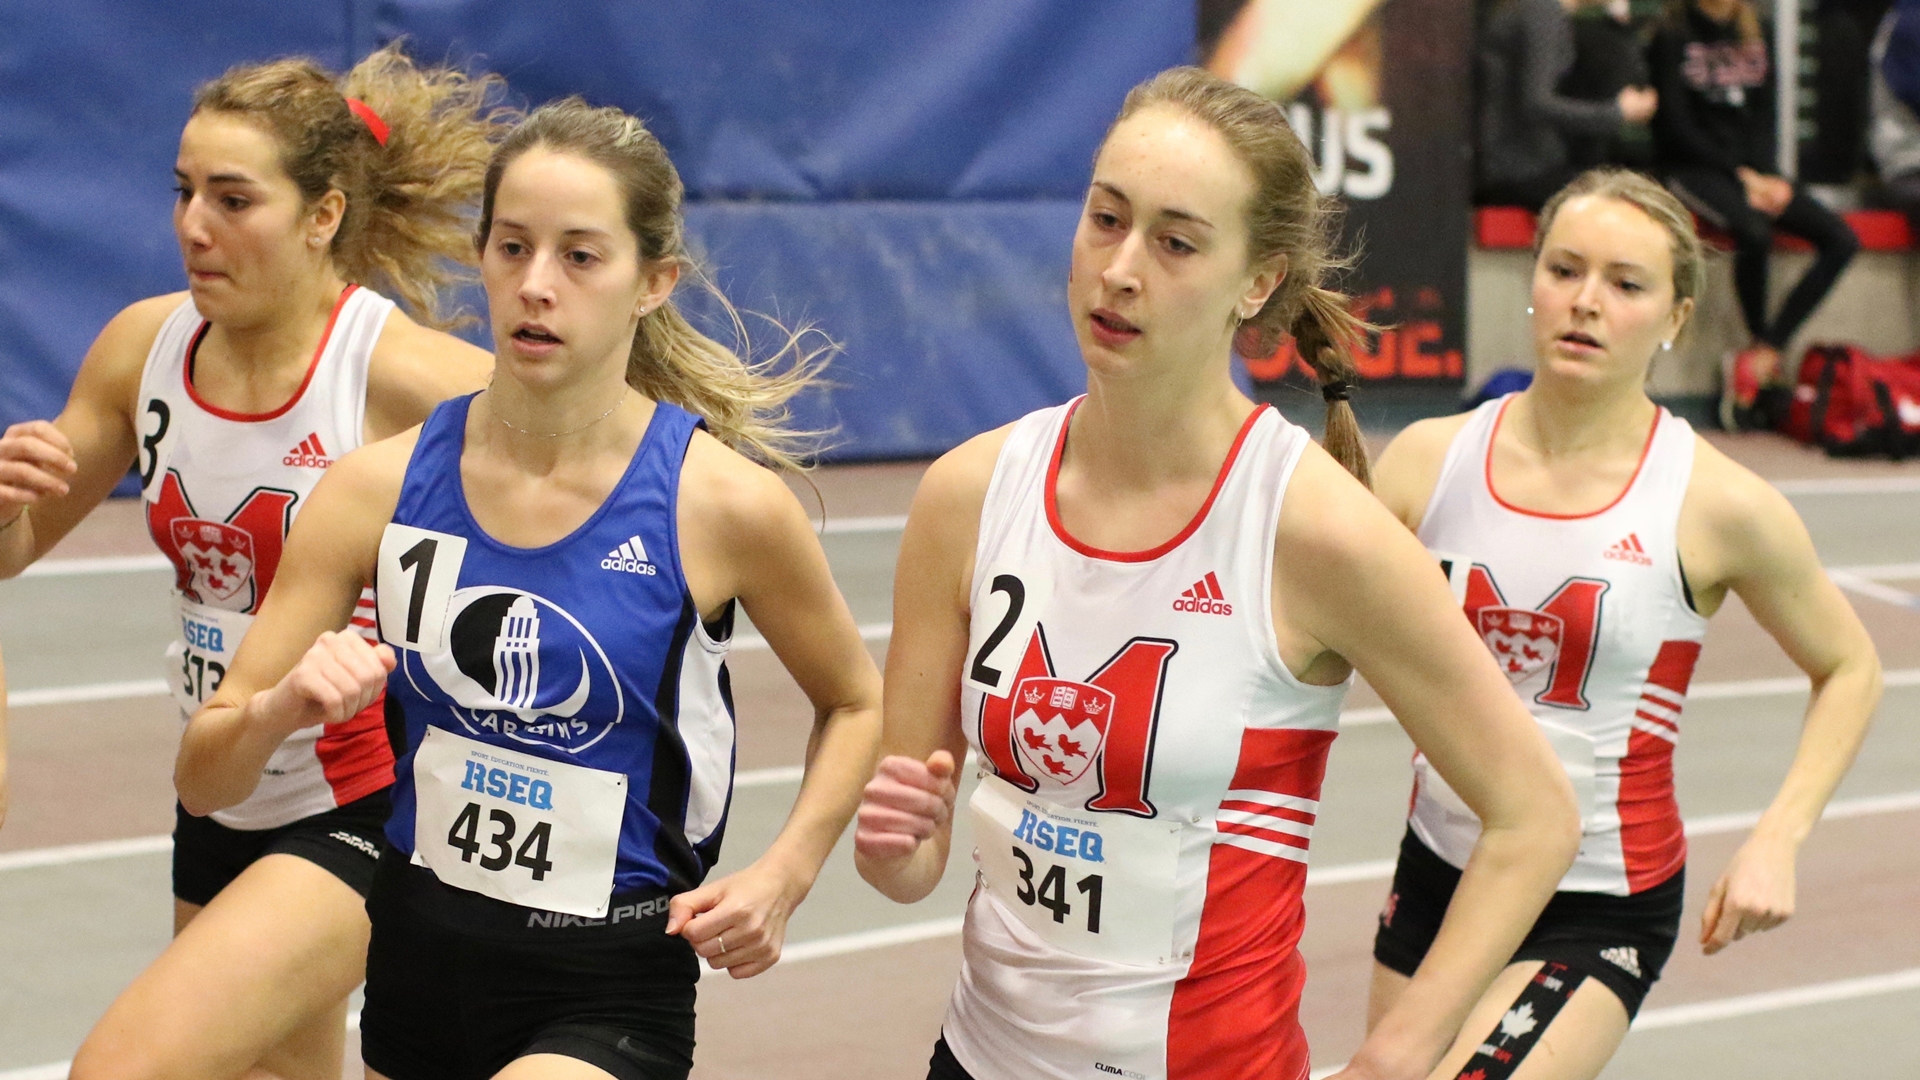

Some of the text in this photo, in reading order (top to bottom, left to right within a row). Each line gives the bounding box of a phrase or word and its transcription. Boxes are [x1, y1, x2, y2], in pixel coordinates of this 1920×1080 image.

[140, 398, 170, 491] 3
[399, 538, 439, 644] 1
[600, 557, 657, 576] adidas
[970, 574, 1026, 688] 2
[1172, 597, 1233, 616] adidas
[471, 709, 589, 740] CARINS
[461, 759, 554, 811] RSEQ
[447, 802, 553, 881] 434
[1013, 808, 1105, 863] RSEQ
[527, 895, 670, 928] NIK PRO
[1012, 846, 1104, 934] 341
